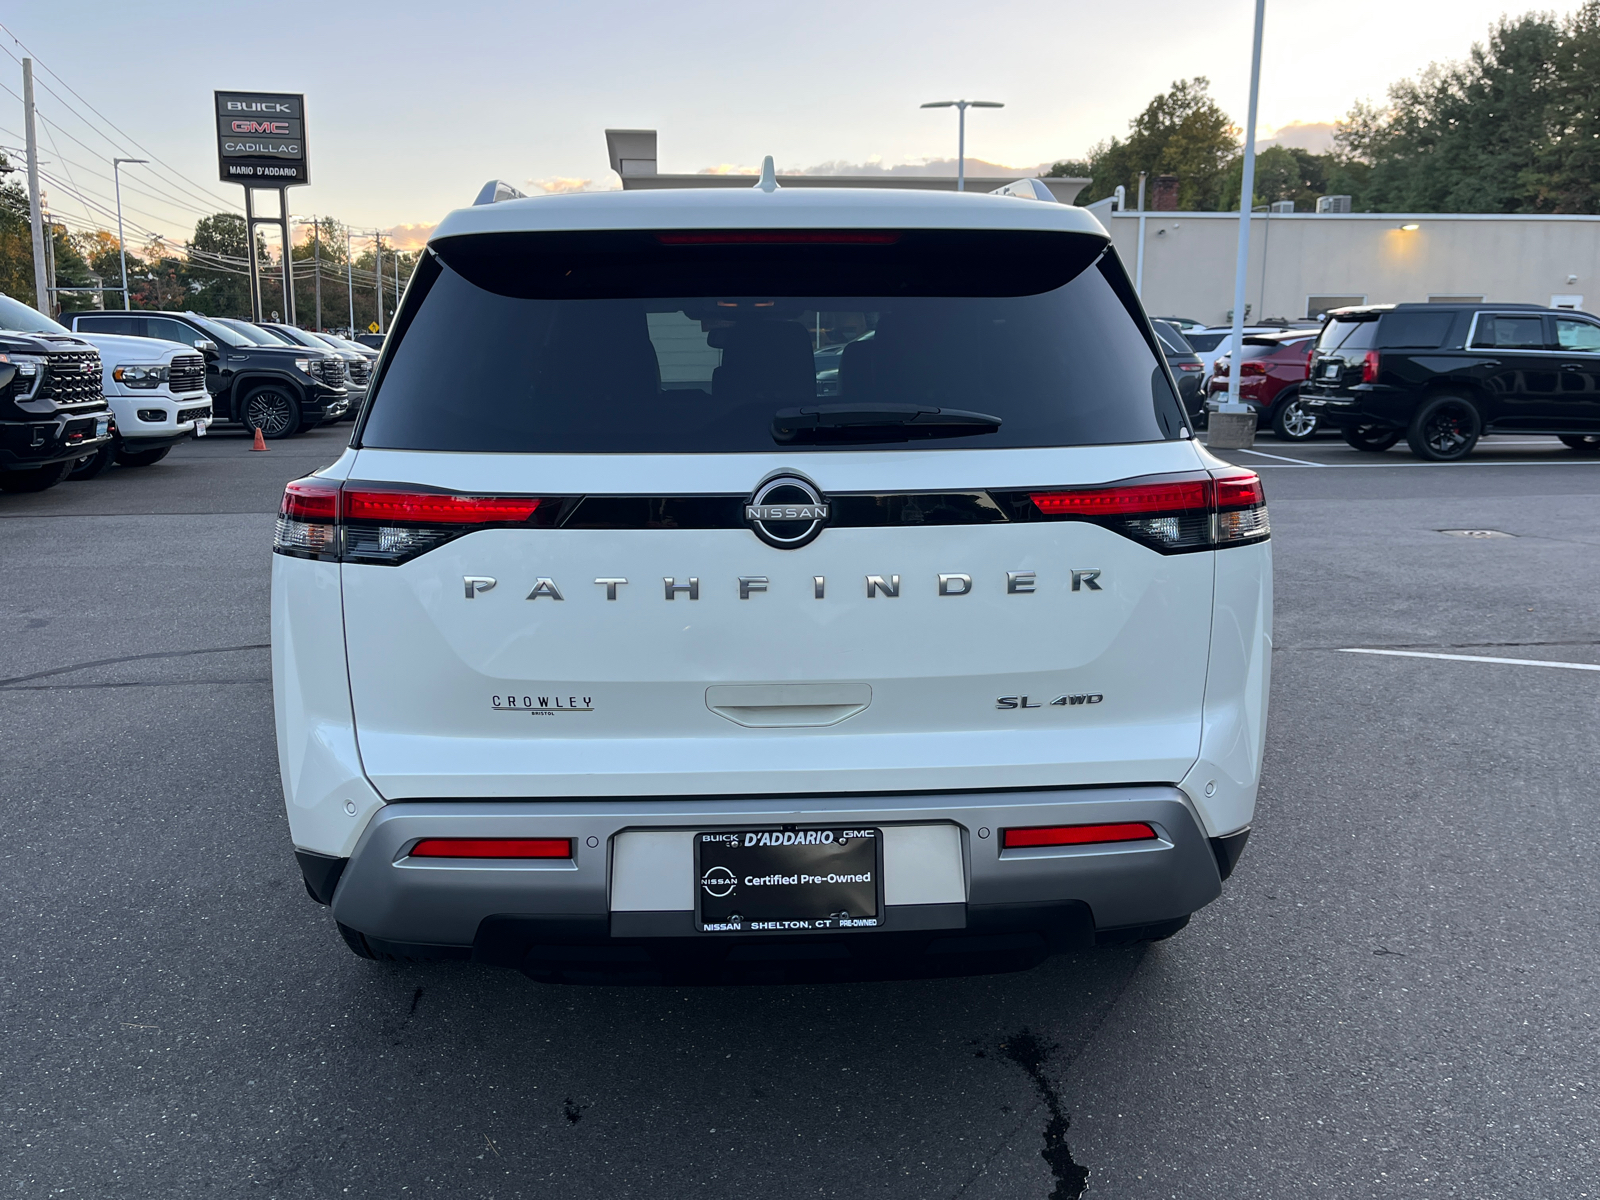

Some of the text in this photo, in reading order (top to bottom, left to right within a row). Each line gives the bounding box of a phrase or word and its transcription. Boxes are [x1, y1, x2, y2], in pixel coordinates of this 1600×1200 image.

[227, 101, 291, 113] BUICK
[232, 120, 289, 134] GMC
[225, 142, 298, 153] CADILLAC
[229, 165, 297, 177] MARIO D'ADDARIO
[748, 507, 827, 518] NISSAN
[463, 567, 1103, 600] PATHFINDER
[492, 695, 592, 708] CROWLEY
[995, 692, 1103, 710] SL 4WD
[702, 830, 875, 847] BUICK D'ADDARIO GMC
[744, 872, 871, 886] Certified Pre-Owned
[703, 919, 877, 931] NISSAN SHELTON, CT PRE-OWNED
